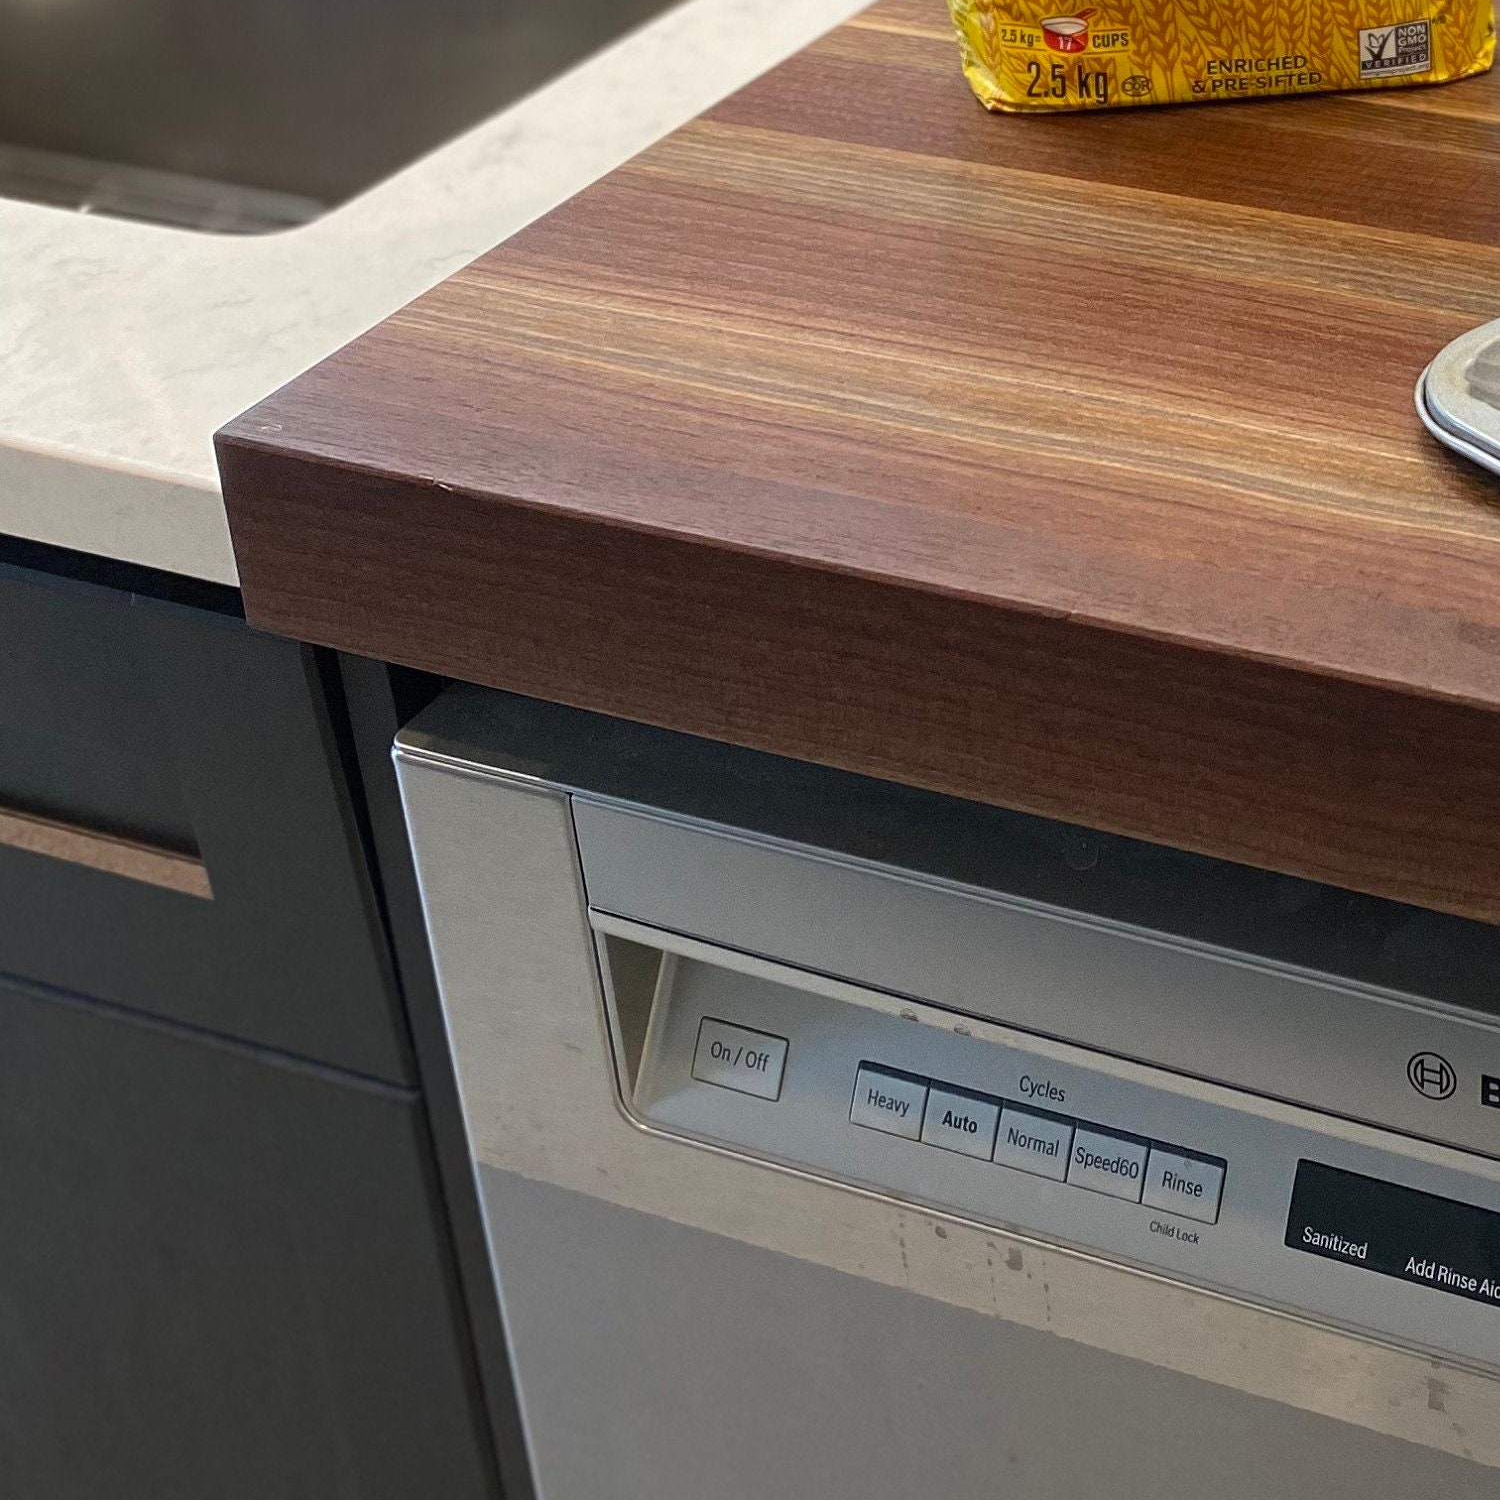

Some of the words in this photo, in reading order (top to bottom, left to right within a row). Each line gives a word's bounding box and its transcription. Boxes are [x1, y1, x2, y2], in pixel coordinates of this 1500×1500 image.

[1058, 36, 1072, 50] 17
[1092, 32, 1129, 49] CUPS
[1398, 24, 1426, 37] NON
[1398, 33, 1426, 46] GMO
[1207, 55, 1308, 75] ENRICHED
[1365, 53, 1426, 68] VERIFIED
[1027, 61, 1067, 99] 2.5
[1077, 64, 1109, 105] kg
[1192, 80, 1206, 93] &
[1211, 72, 1322, 92] PRE-SIFTED
[710, 1041, 731, 1063] On
[745, 1051, 771, 1074] Off
[867, 1088, 910, 1118] Heavy
[1019, 1075, 1066, 1103] Cycles
[942, 1110, 978, 1135] Auto
[1007, 1127, 1060, 1158] Normal
[1074, 1147, 1140, 1180] Speed60
[1161, 1170, 1203, 1198] Rinse
[1150, 1221, 1175, 1237] Child
[1176, 1228, 1200, 1244] Lock
[1302, 1226, 1368, 1260] Sanitized
[1405, 1257, 1436, 1280] Add
[1438, 1264, 1477, 1293] Rinse
